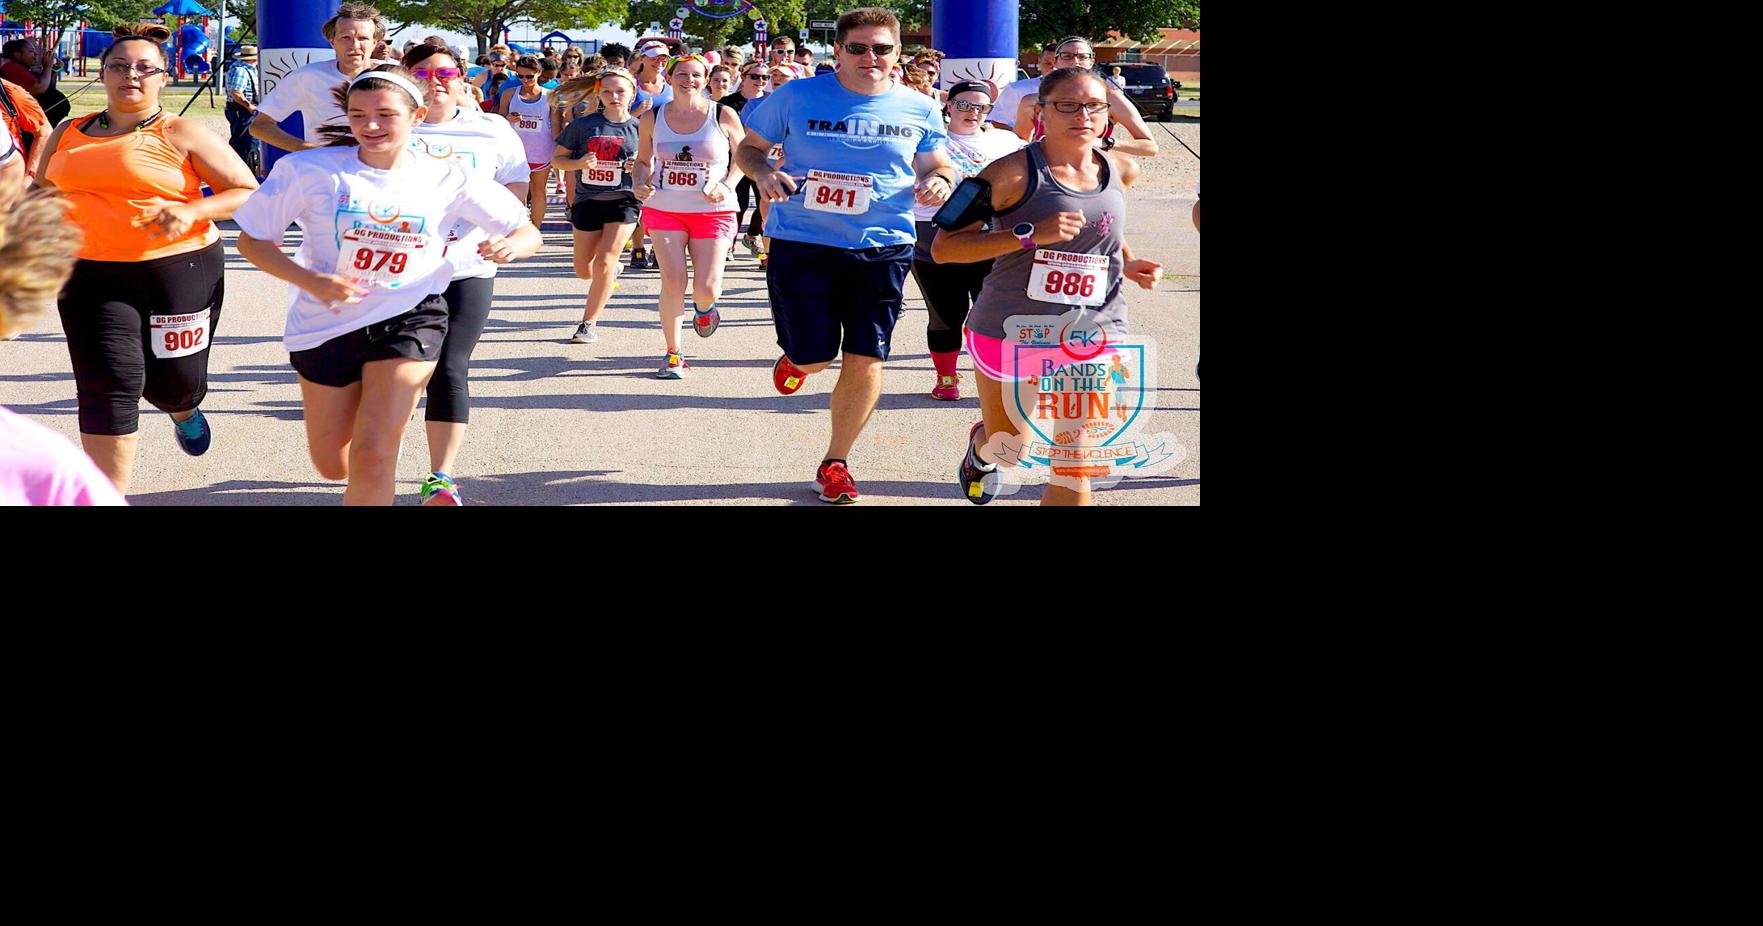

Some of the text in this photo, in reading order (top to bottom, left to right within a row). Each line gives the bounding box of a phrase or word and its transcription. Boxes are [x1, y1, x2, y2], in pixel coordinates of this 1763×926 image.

[519, 120, 538, 129] 980
[807, 119, 913, 137] TRAINING
[770, 147, 784, 157] 78
[588, 168, 615, 182] 959
[668, 171, 698, 187] 968
[813, 170, 870, 183] DG PRODUCTIONS
[816, 185, 856, 209] 941
[353, 228, 423, 243] DG PRODUCTIONS
[354, 248, 407, 274] 979
[1042, 250, 1108, 265] DG PRODUCTIONS
[1045, 271, 1095, 297] 986
[165, 327, 203, 351] 902
